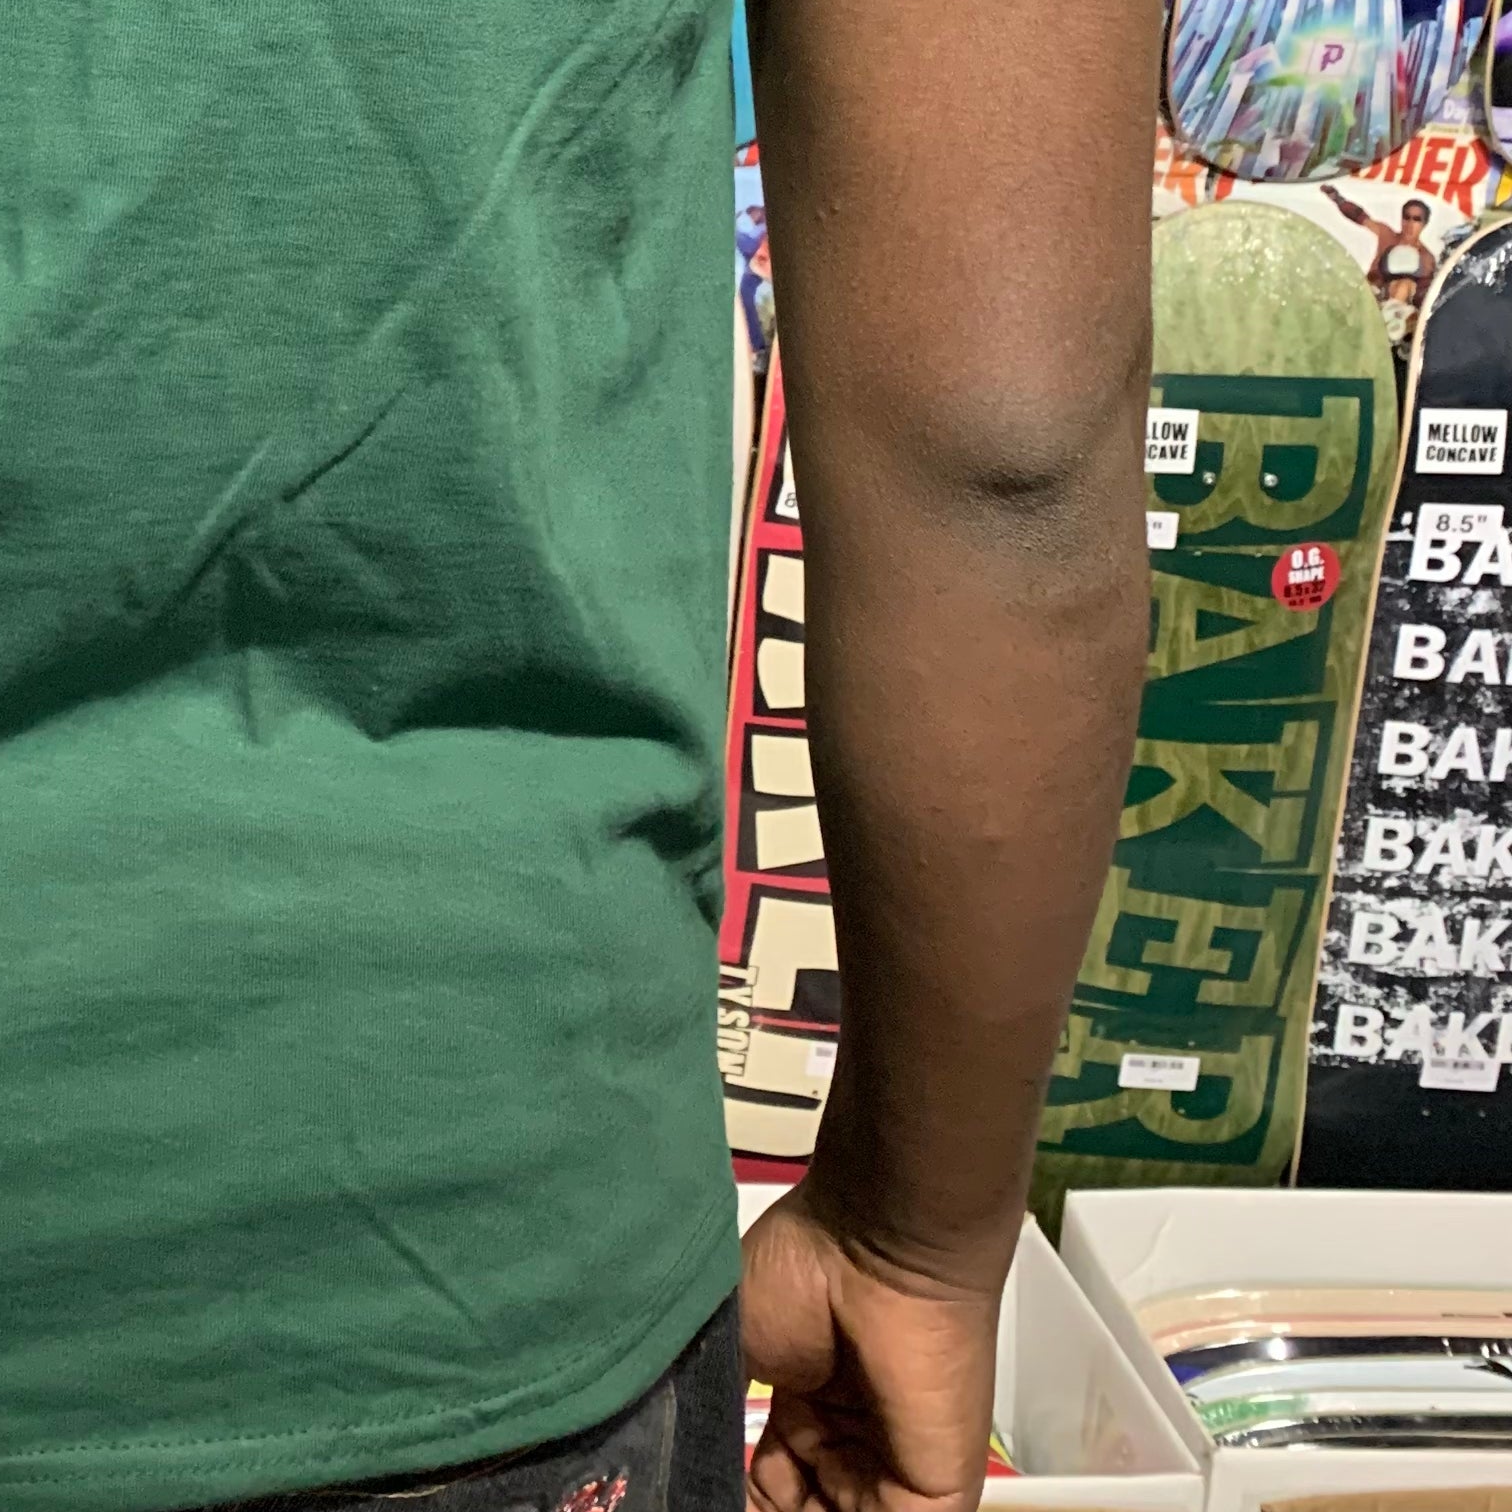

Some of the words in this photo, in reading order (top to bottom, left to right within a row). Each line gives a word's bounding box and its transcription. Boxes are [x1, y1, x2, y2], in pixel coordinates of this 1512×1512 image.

[1146, 421, 1190, 442] LOW
[1427, 422, 1499, 444] MELLOW
[1425, 444, 1498, 463] CONCAVE
[1435, 513, 1488, 534] 8.5"
